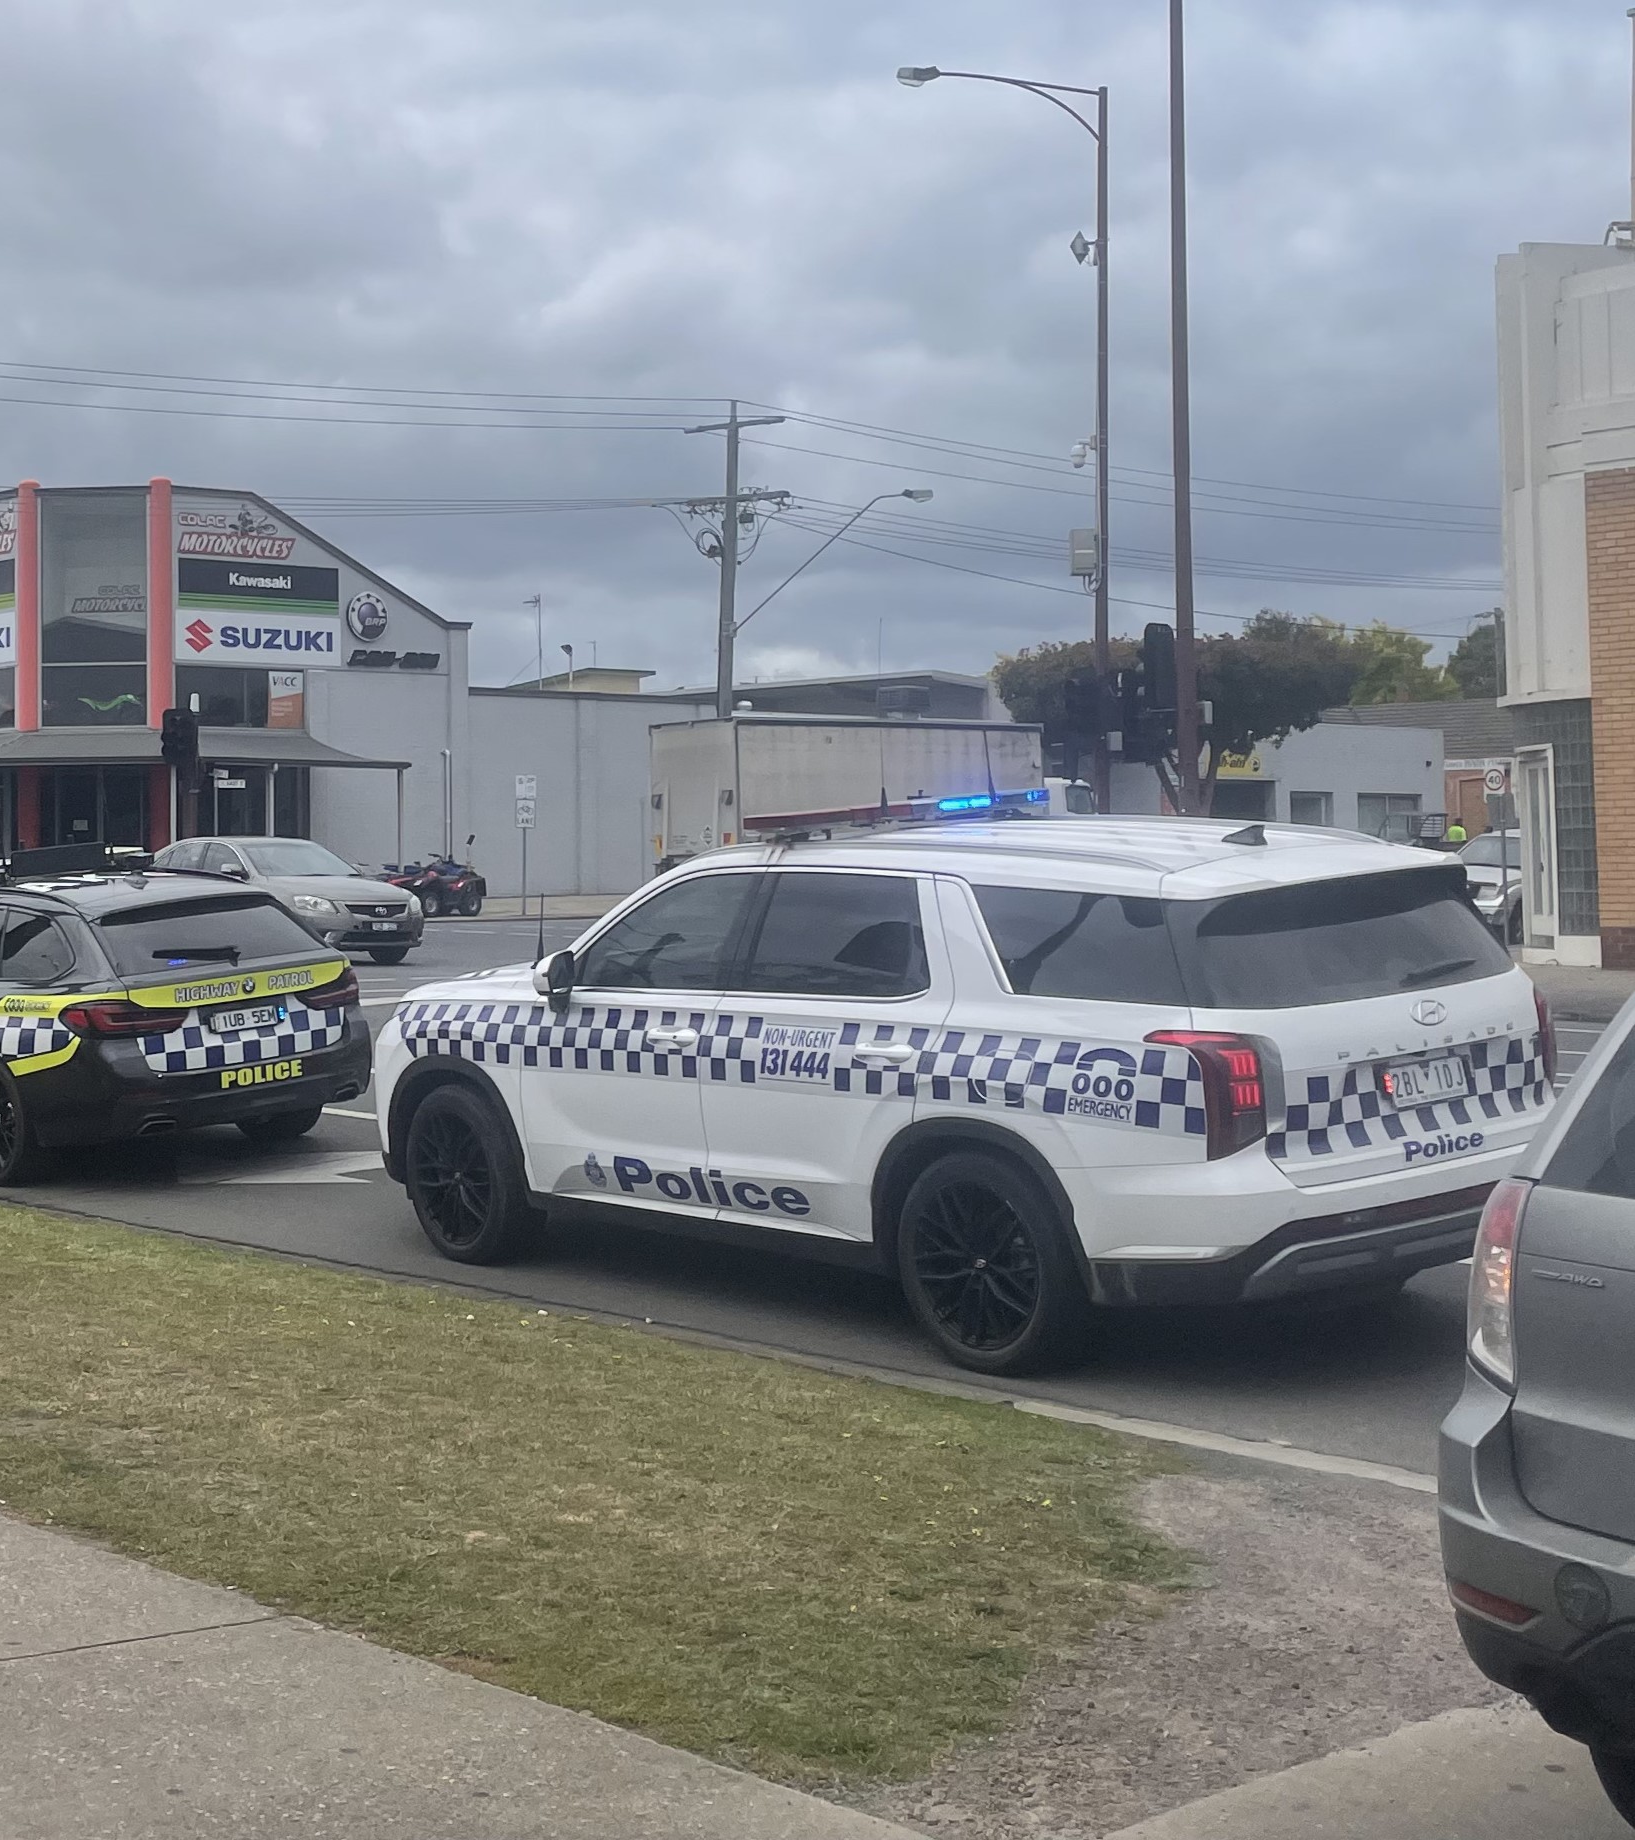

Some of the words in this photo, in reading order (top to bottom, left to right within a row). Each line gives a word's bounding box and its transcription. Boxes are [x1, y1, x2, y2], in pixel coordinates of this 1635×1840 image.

[178, 512, 226, 528] COLAC
[179, 534, 293, 559] MOTORCYCLES
[229, 572, 292, 590] Kawasaki
[365, 617, 386, 626] BRP
[219, 626, 333, 652] SUZUKI
[272, 676, 297, 687] VACC
[1488, 775, 1501, 785] 40
[175, 980, 240, 1003] HIGHWAY
[268, 970, 314, 990] PATROL
[223, 1013, 245, 1028] 1UB
[251, 1008, 276, 1024] 5EM
[763, 1027, 837, 1049] NON-URGENT
[1338, 1022, 1513, 1060] PALISADE
[220, 1059, 303, 1089] POLICE
[760, 1047, 789, 1075] 131
[790, 1051, 830, 1079] 444
[1072, 1073, 1134, 1101] 000
[1392, 1070, 1424, 1098] 2BL
[1434, 1060, 1464, 1090] 1DJ
[1067, 1097, 1132, 1120] EMERGENCY
[1403, 1132, 1484, 1162] Police
[614, 1155, 811, 1215] Police
